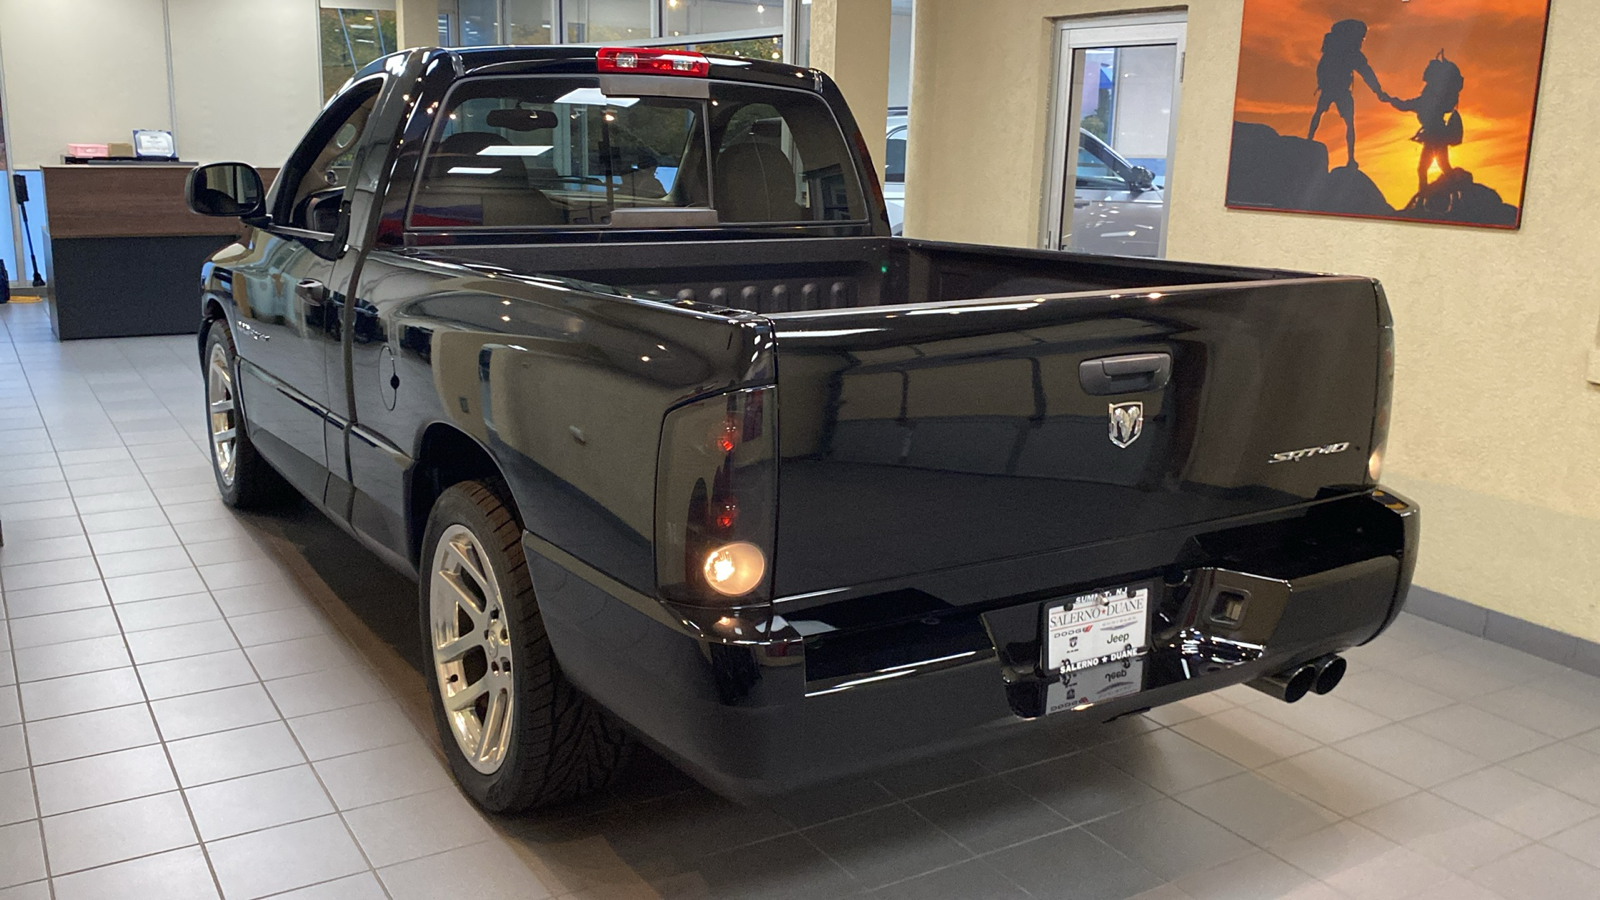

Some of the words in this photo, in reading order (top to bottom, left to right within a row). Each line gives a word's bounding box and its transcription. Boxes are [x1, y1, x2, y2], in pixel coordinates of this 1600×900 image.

[1050, 607, 1100, 628] SALERNO
[1106, 598, 1143, 616] DUANE
[1106, 633, 1129, 644] Jeep
[1060, 657, 1099, 674] SALERNO
[1110, 648, 1138, 661] DUANE
